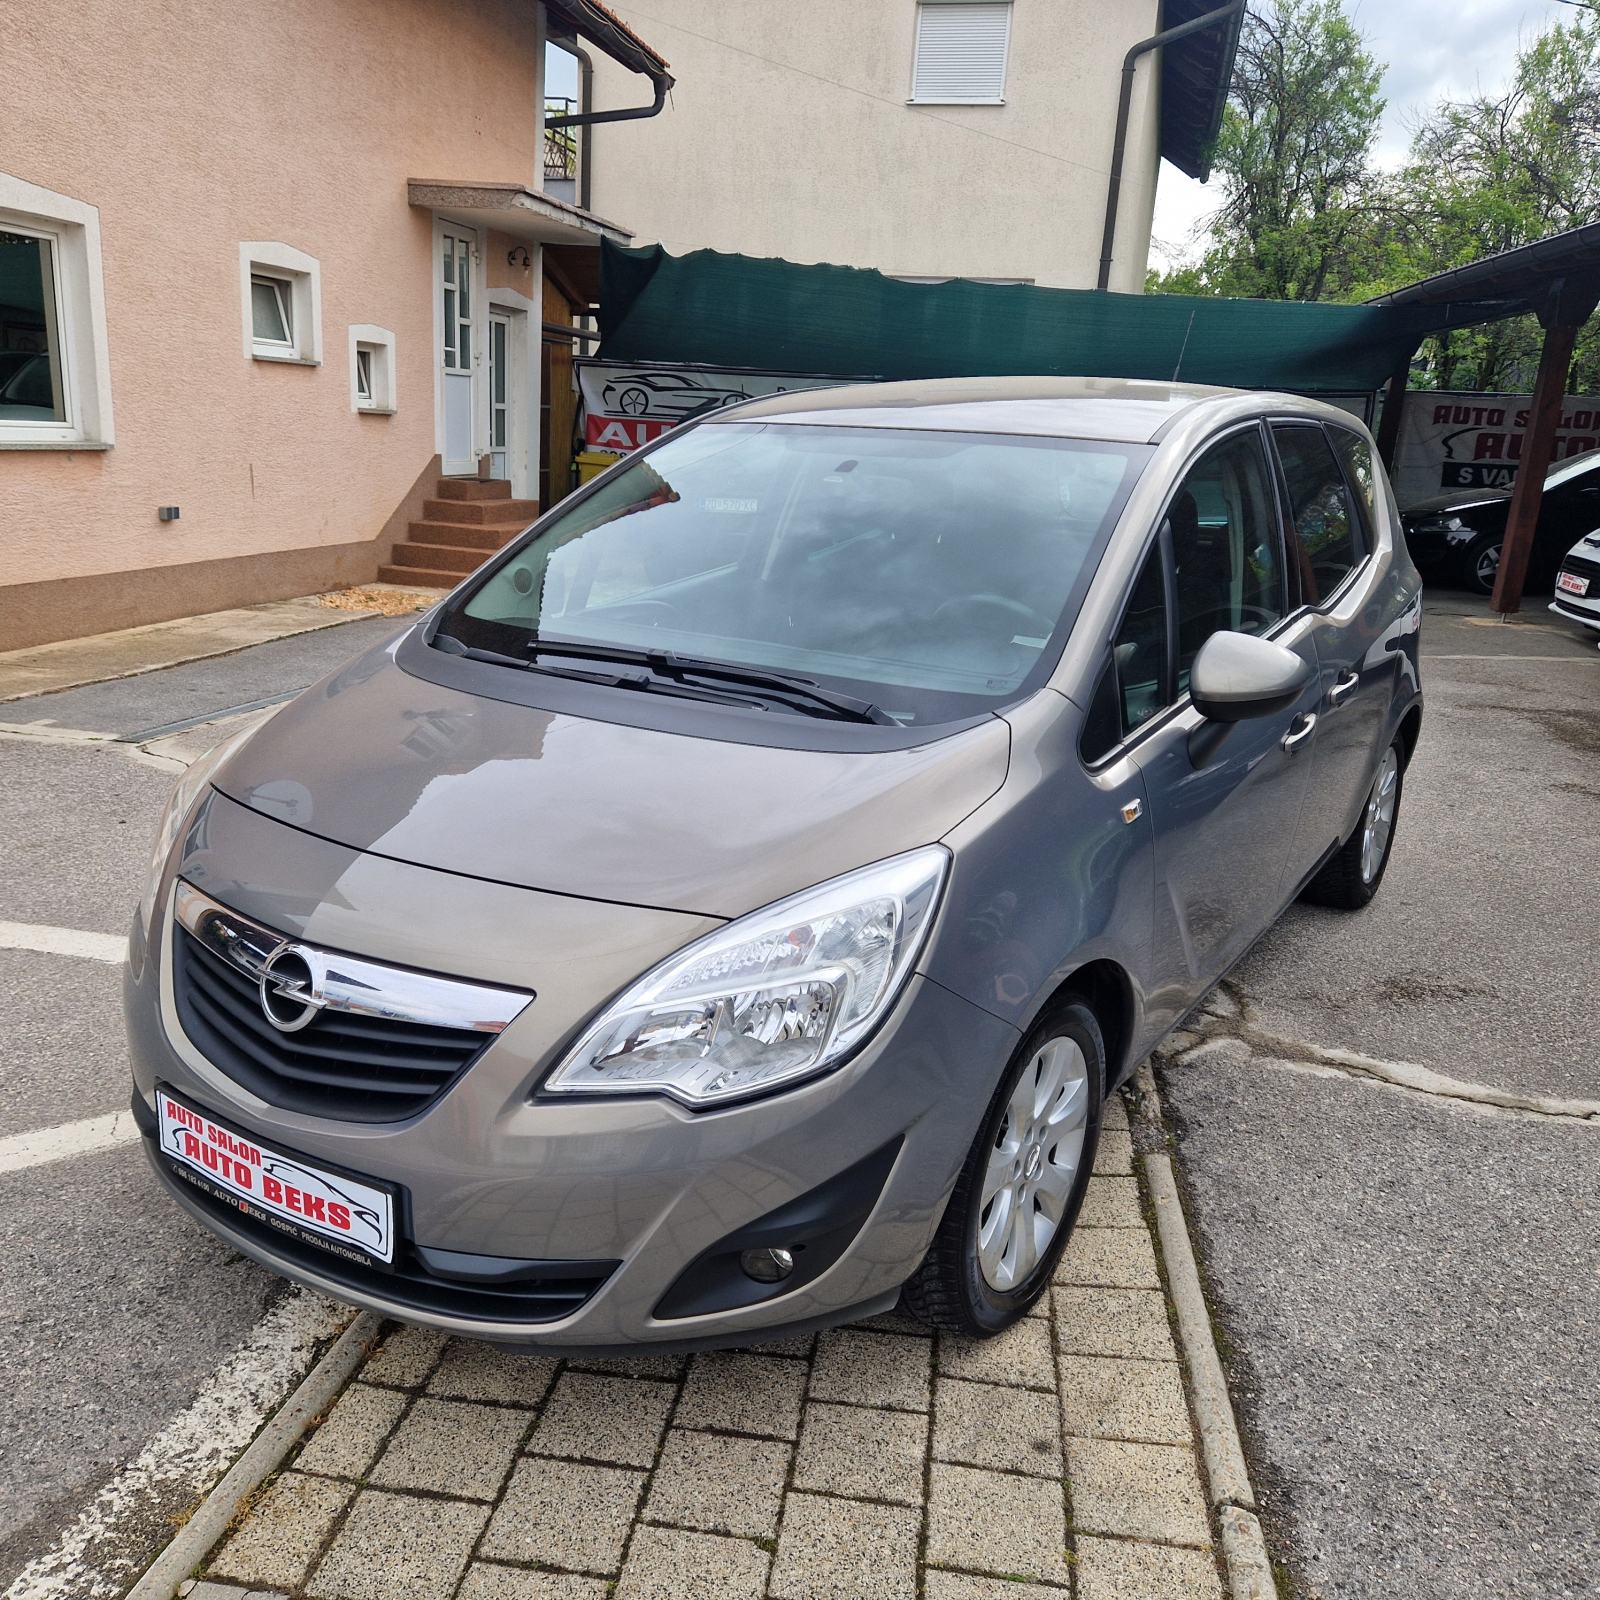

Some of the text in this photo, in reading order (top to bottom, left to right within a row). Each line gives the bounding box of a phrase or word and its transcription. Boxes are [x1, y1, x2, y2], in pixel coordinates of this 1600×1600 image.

[1433, 405, 1600, 431] AUTO SLO
[1458, 466, 1516, 486] S VA
[167, 1100, 261, 1167] AUTO SALON
[184, 1132, 350, 1230] AUTO BEKS
[213, 1189, 238, 1207] AUTO
[270, 1217, 298, 1236] GOSPIĆ
[301, 1231, 330, 1251] PRODAJA
[330, 1245, 372, 1267] AUTOMOBILA
